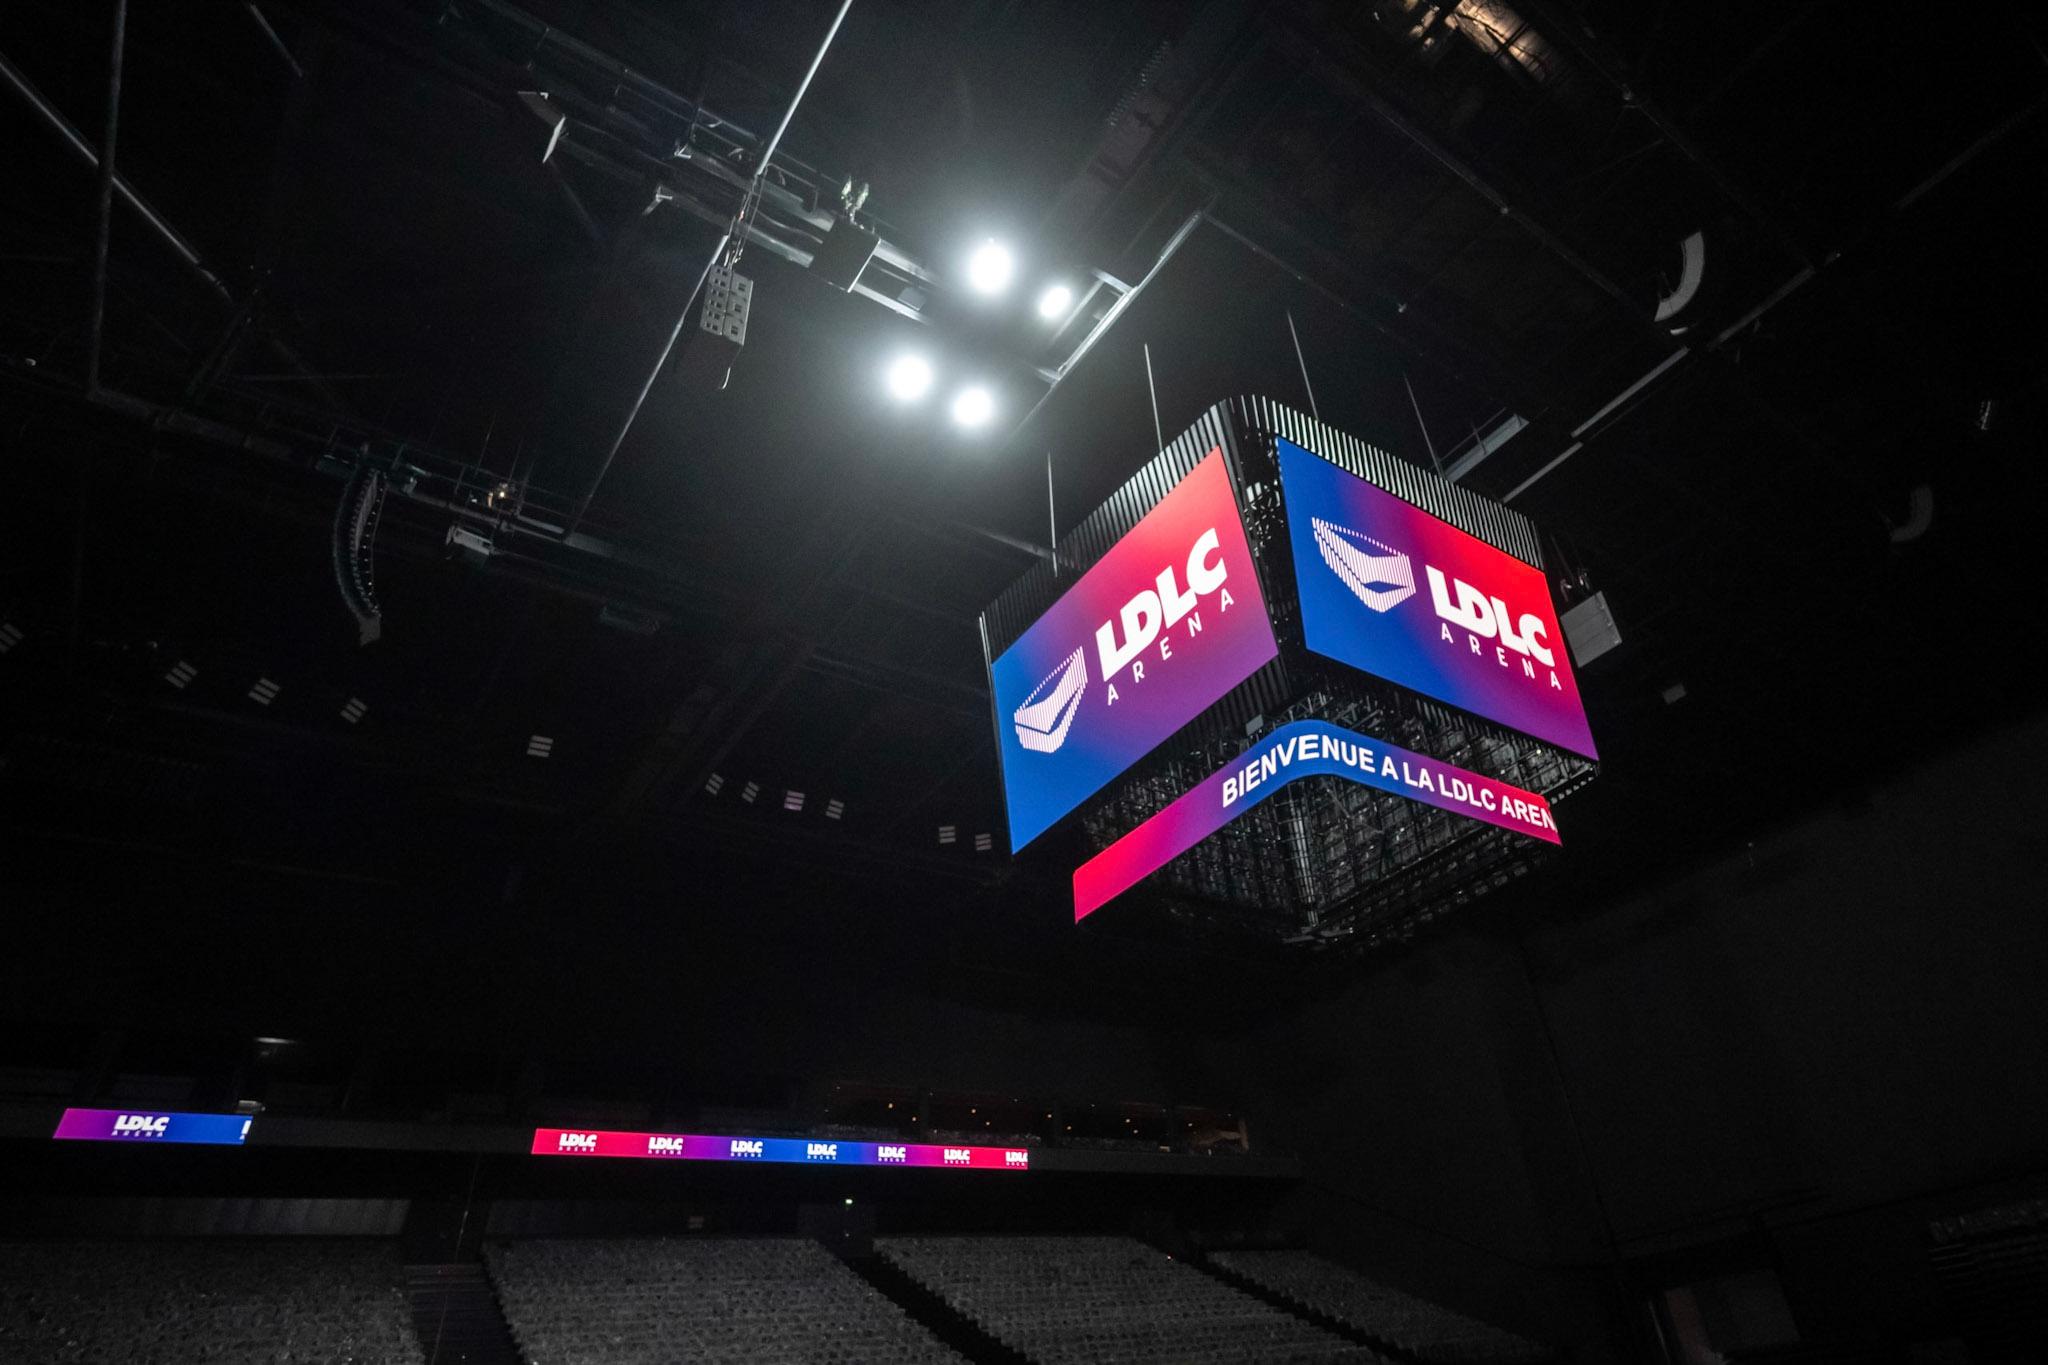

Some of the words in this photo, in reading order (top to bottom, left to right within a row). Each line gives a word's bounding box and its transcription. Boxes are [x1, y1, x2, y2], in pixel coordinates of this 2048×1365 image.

[1095, 527, 1228, 682] LDLC
[1425, 565, 1555, 668] LDLC
[1107, 588, 1234, 706] ARENA
[1441, 622, 1562, 691] ARENA
[1222, 734, 1376, 808] BIENVENUE
[1381, 755, 1399, 781] A
[1402, 762, 1435, 792] LA
[1438, 773, 1496, 812] LDLC
[114, 1115, 170, 1132] LDLC
[559, 1133, 597, 1147] LDLC
[648, 1136, 684, 1151] LDLC
[731, 1140, 763, 1154] LDLC
[807, 1143, 837, 1156] LDLC
[877, 1146, 906, 1159] LDLC
[943, 1149, 971, 1161] LDLC
